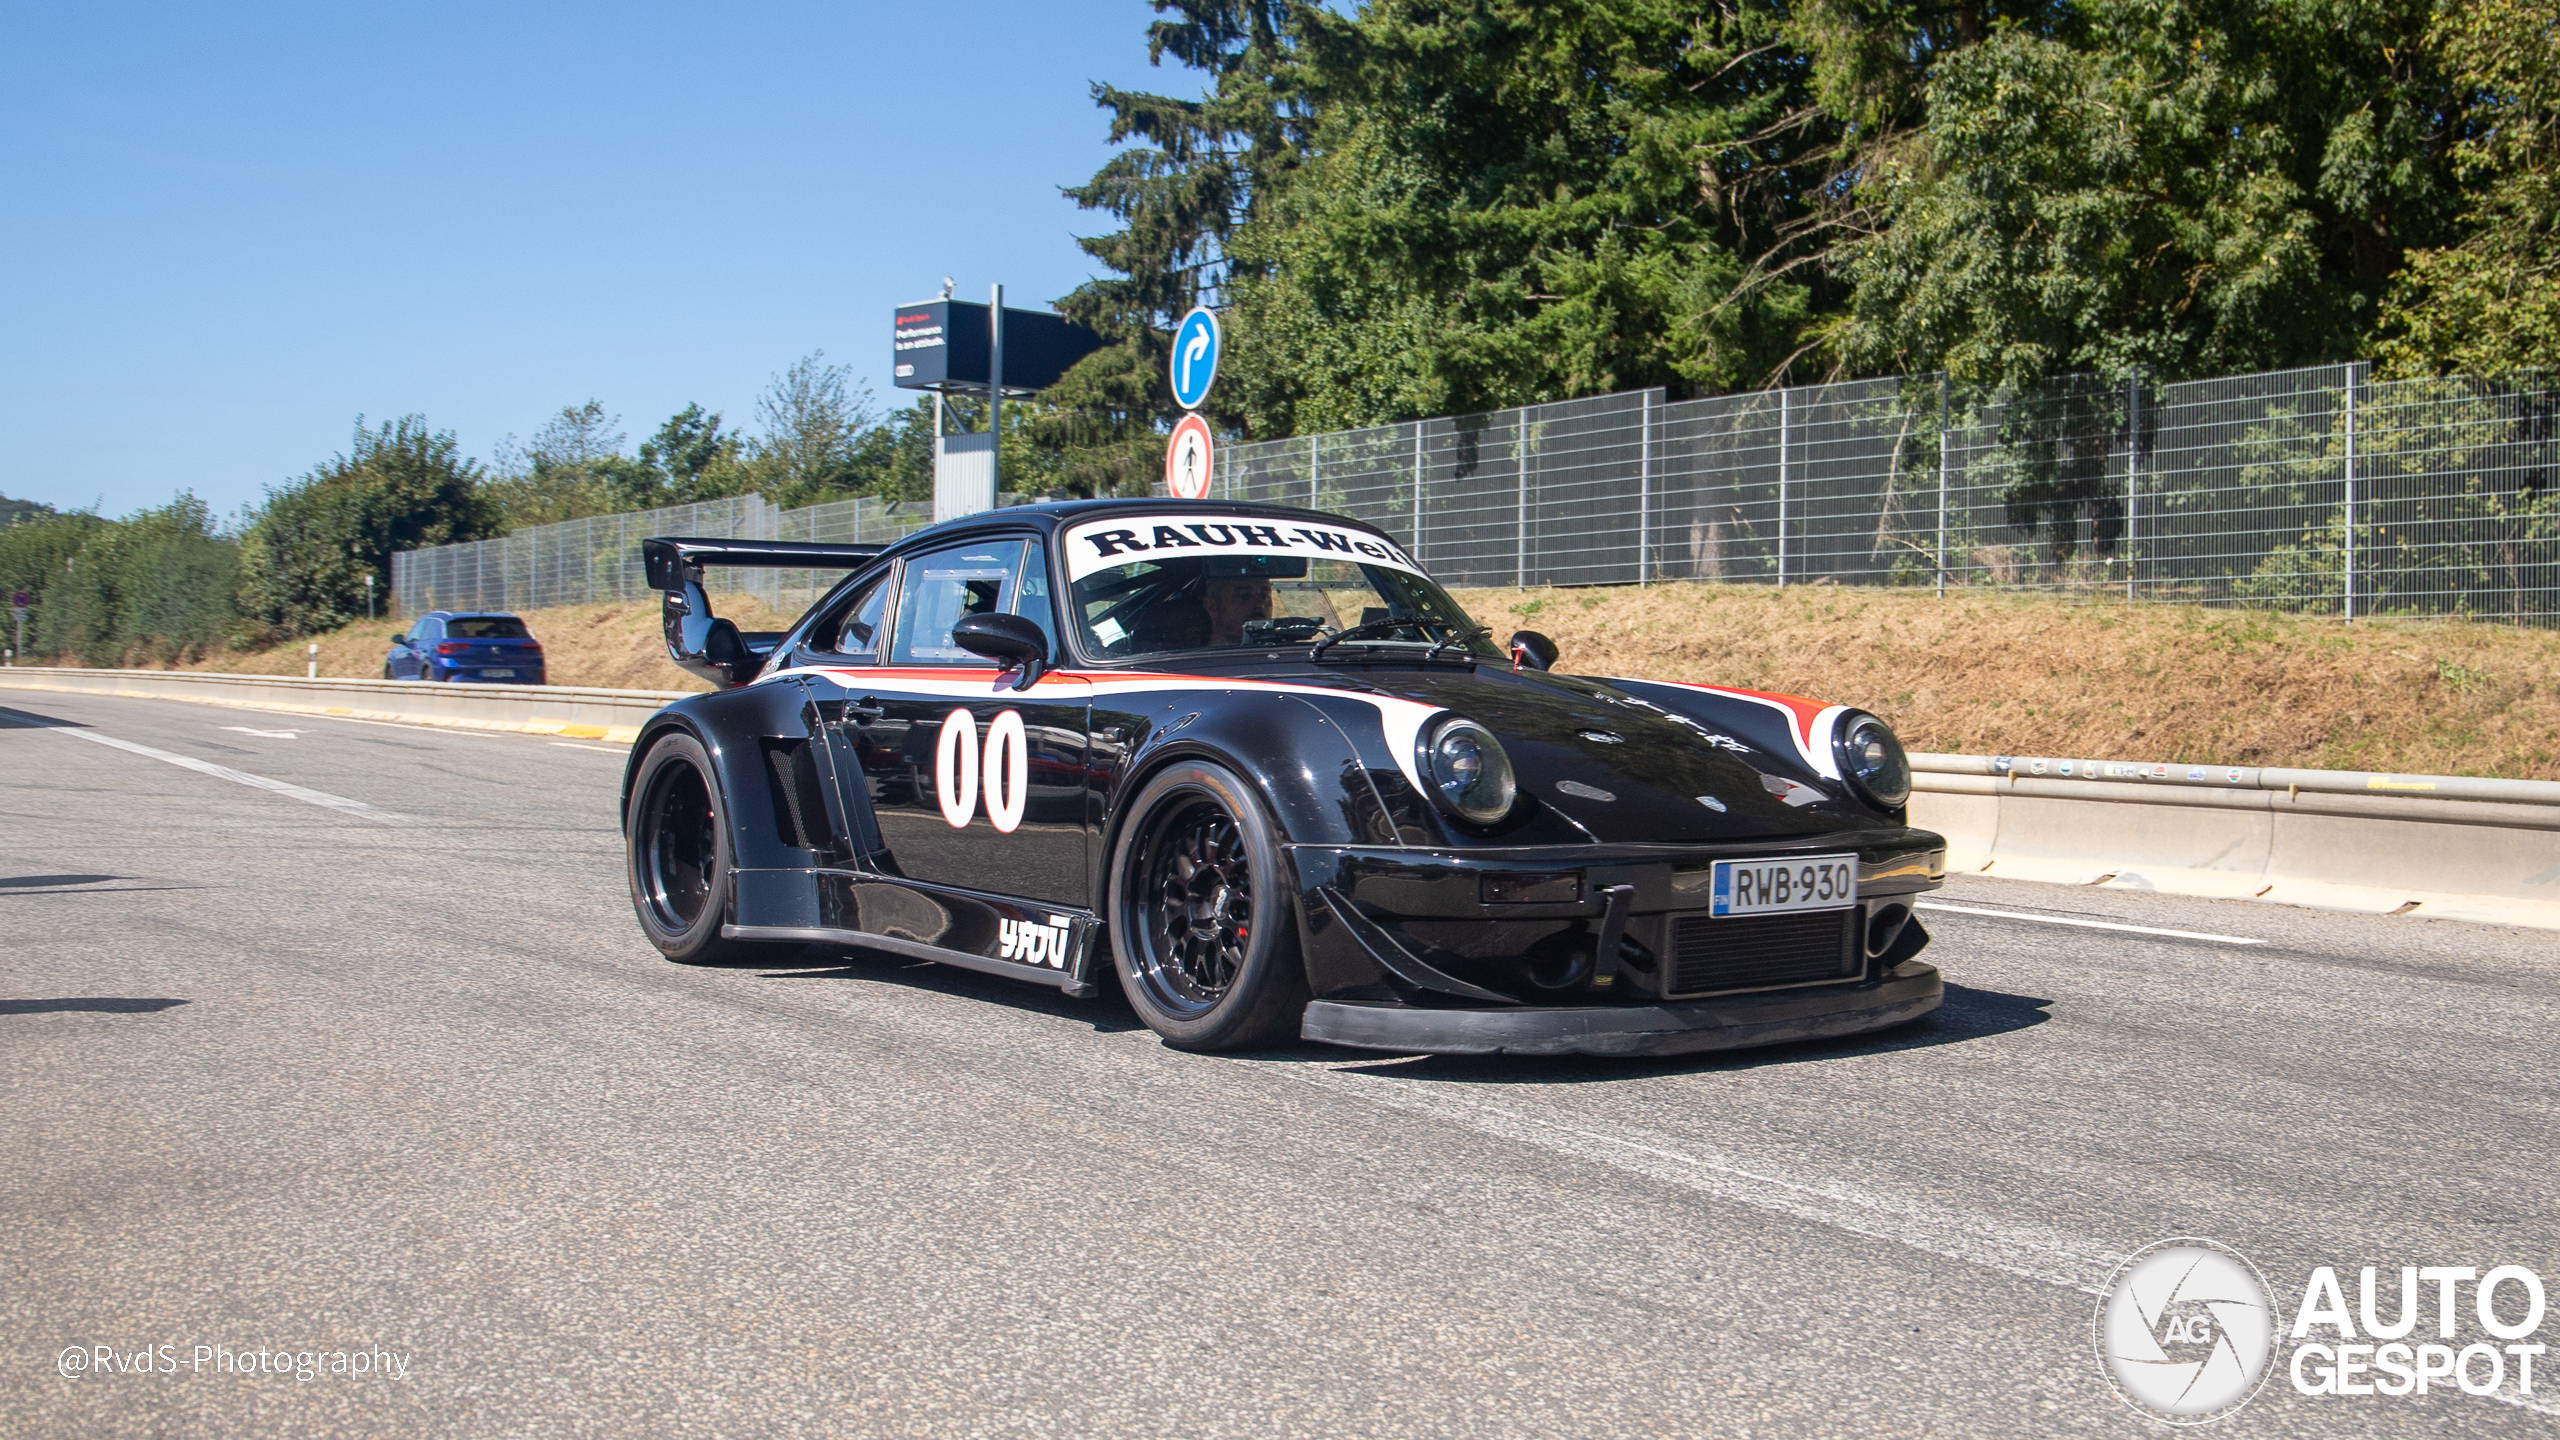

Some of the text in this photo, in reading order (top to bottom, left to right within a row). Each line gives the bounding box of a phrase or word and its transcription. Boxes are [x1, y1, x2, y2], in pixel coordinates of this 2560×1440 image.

[896, 326, 943, 339] Performance
[935, 707, 1028, 834] 00
[1737, 864, 1850, 906] RWB-930
[1714, 894, 1729, 906] FIN
